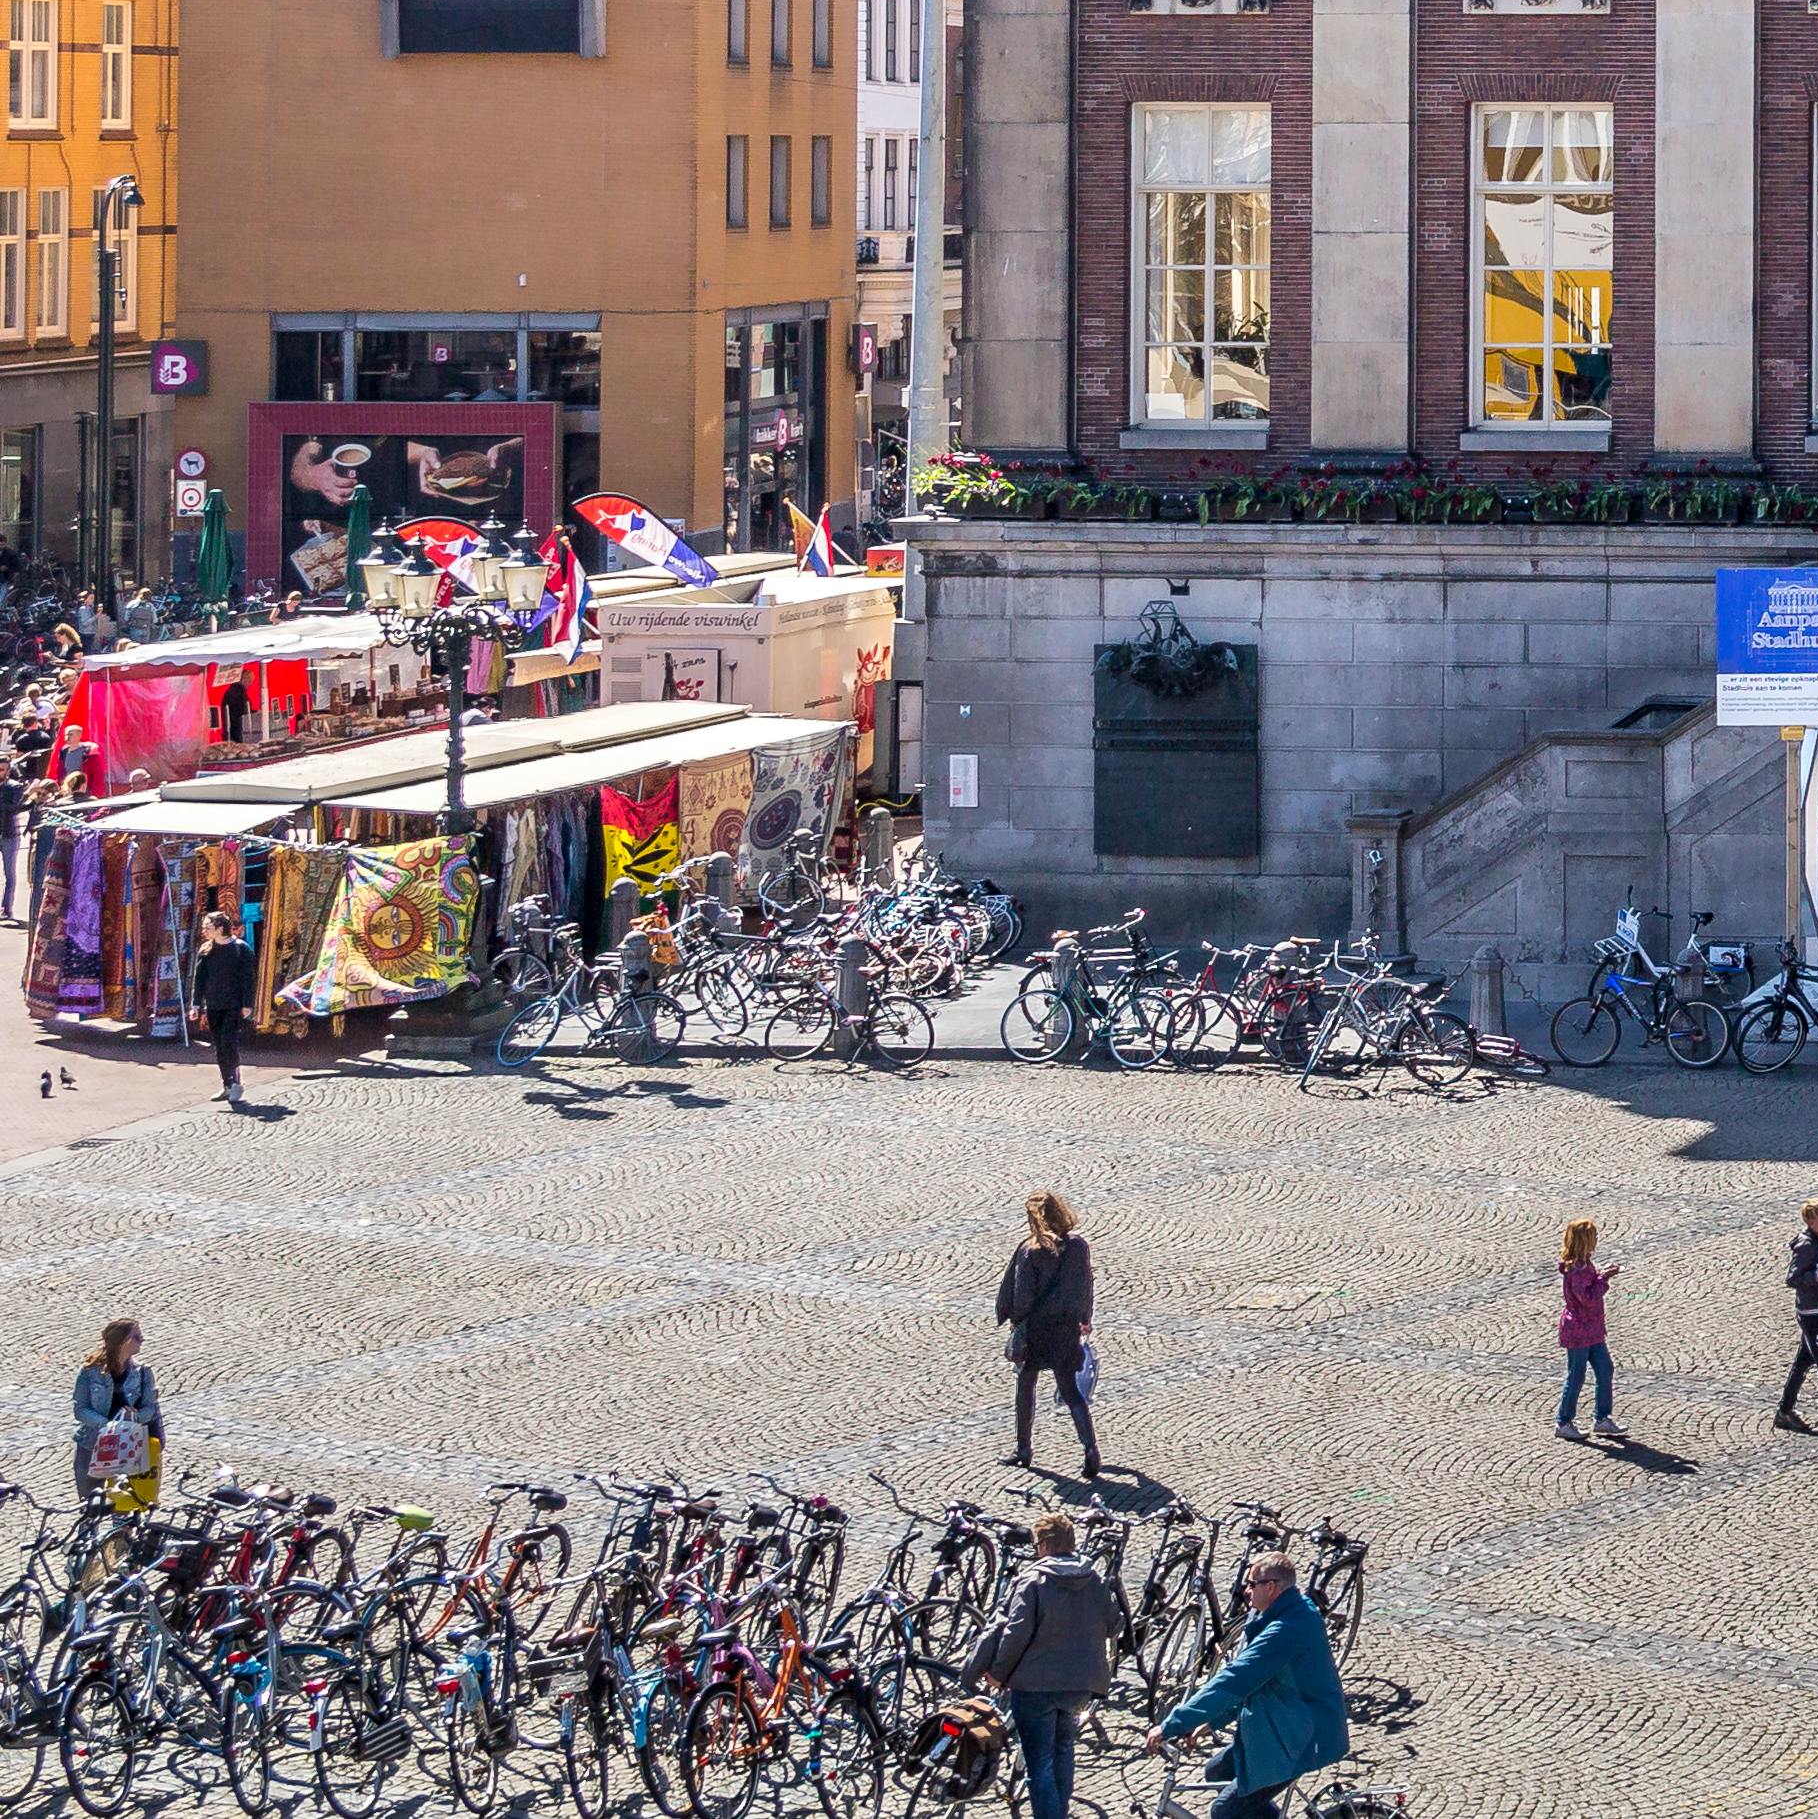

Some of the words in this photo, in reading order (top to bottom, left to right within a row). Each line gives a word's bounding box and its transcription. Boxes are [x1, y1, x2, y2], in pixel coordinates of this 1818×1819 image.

[159, 355, 188, 385] B
[608, 612, 635, 627] Uw
[639, 611, 691, 632] rijdende
[694, 611, 763, 631] viswinkel
